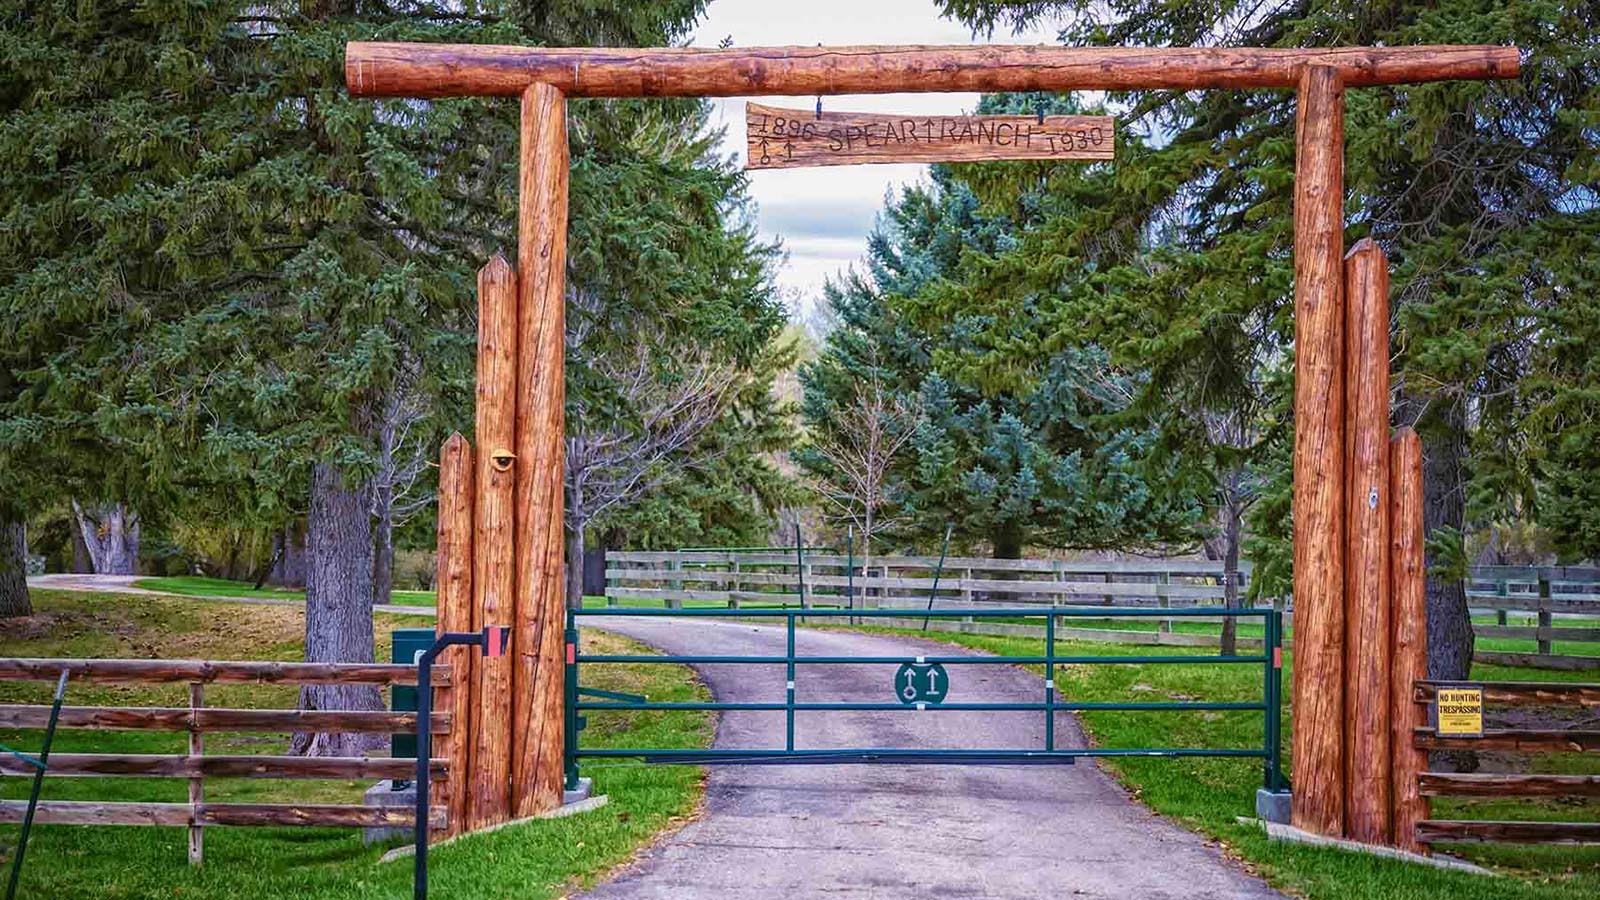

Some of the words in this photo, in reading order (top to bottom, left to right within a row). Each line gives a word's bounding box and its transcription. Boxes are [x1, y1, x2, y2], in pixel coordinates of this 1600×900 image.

[758, 114, 815, 140] 1896
[828, 119, 925, 152] SPEAR
[941, 118, 1033, 149] RANCH
[1047, 126, 1103, 155] 1930
[1439, 693, 1449, 702] NO
[1450, 693, 1480, 702] HUNTING
[1439, 705, 1480, 714] TRESPASSING
